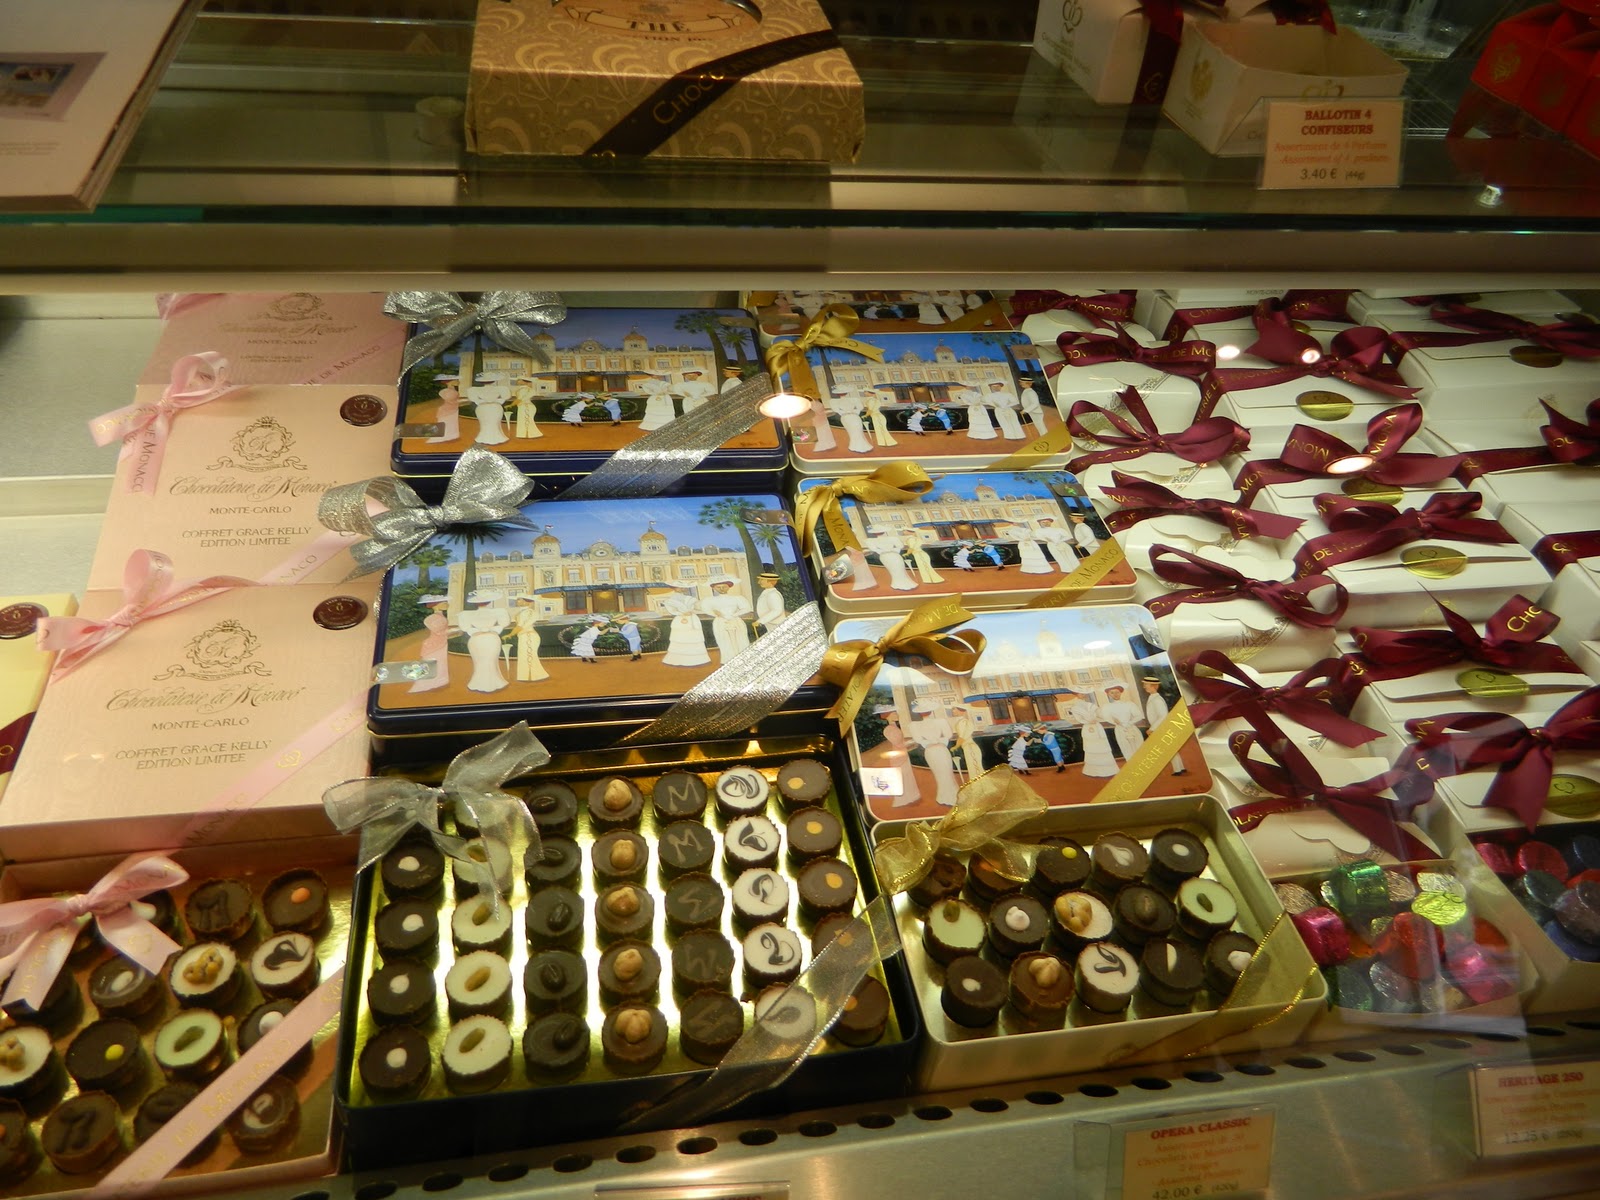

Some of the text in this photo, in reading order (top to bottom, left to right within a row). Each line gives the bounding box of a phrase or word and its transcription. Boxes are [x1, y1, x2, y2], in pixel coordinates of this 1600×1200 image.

[1305, 109, 1372, 120] BALLOTIN 4
[1301, 124, 1374, 136] CONFISEURS
[1300, 168, 1327, 180] 3.40
[1329, 168, 1338, 179] €
[169, 476, 254, 495] Chocolaterie
[209, 505, 292, 516] MONTE-CARLO
[182, 526, 312, 539] COFFRET GRACE KELLY
[200, 537, 291, 548] EDITION LIMITEE
[1312, 547, 1333, 562] DE
[1079, 548, 1119, 581] MONACO
[152, 717, 250, 731] MONTE-CARLO
[115, 739, 272, 760] COFFRET GRACE KELLY
[136, 752, 247, 770] EDITION LIMITEE
[1151, 1117, 1251, 1140] OPERA CLASSIC
[1152, 1186, 1190, 1200] 42.00
